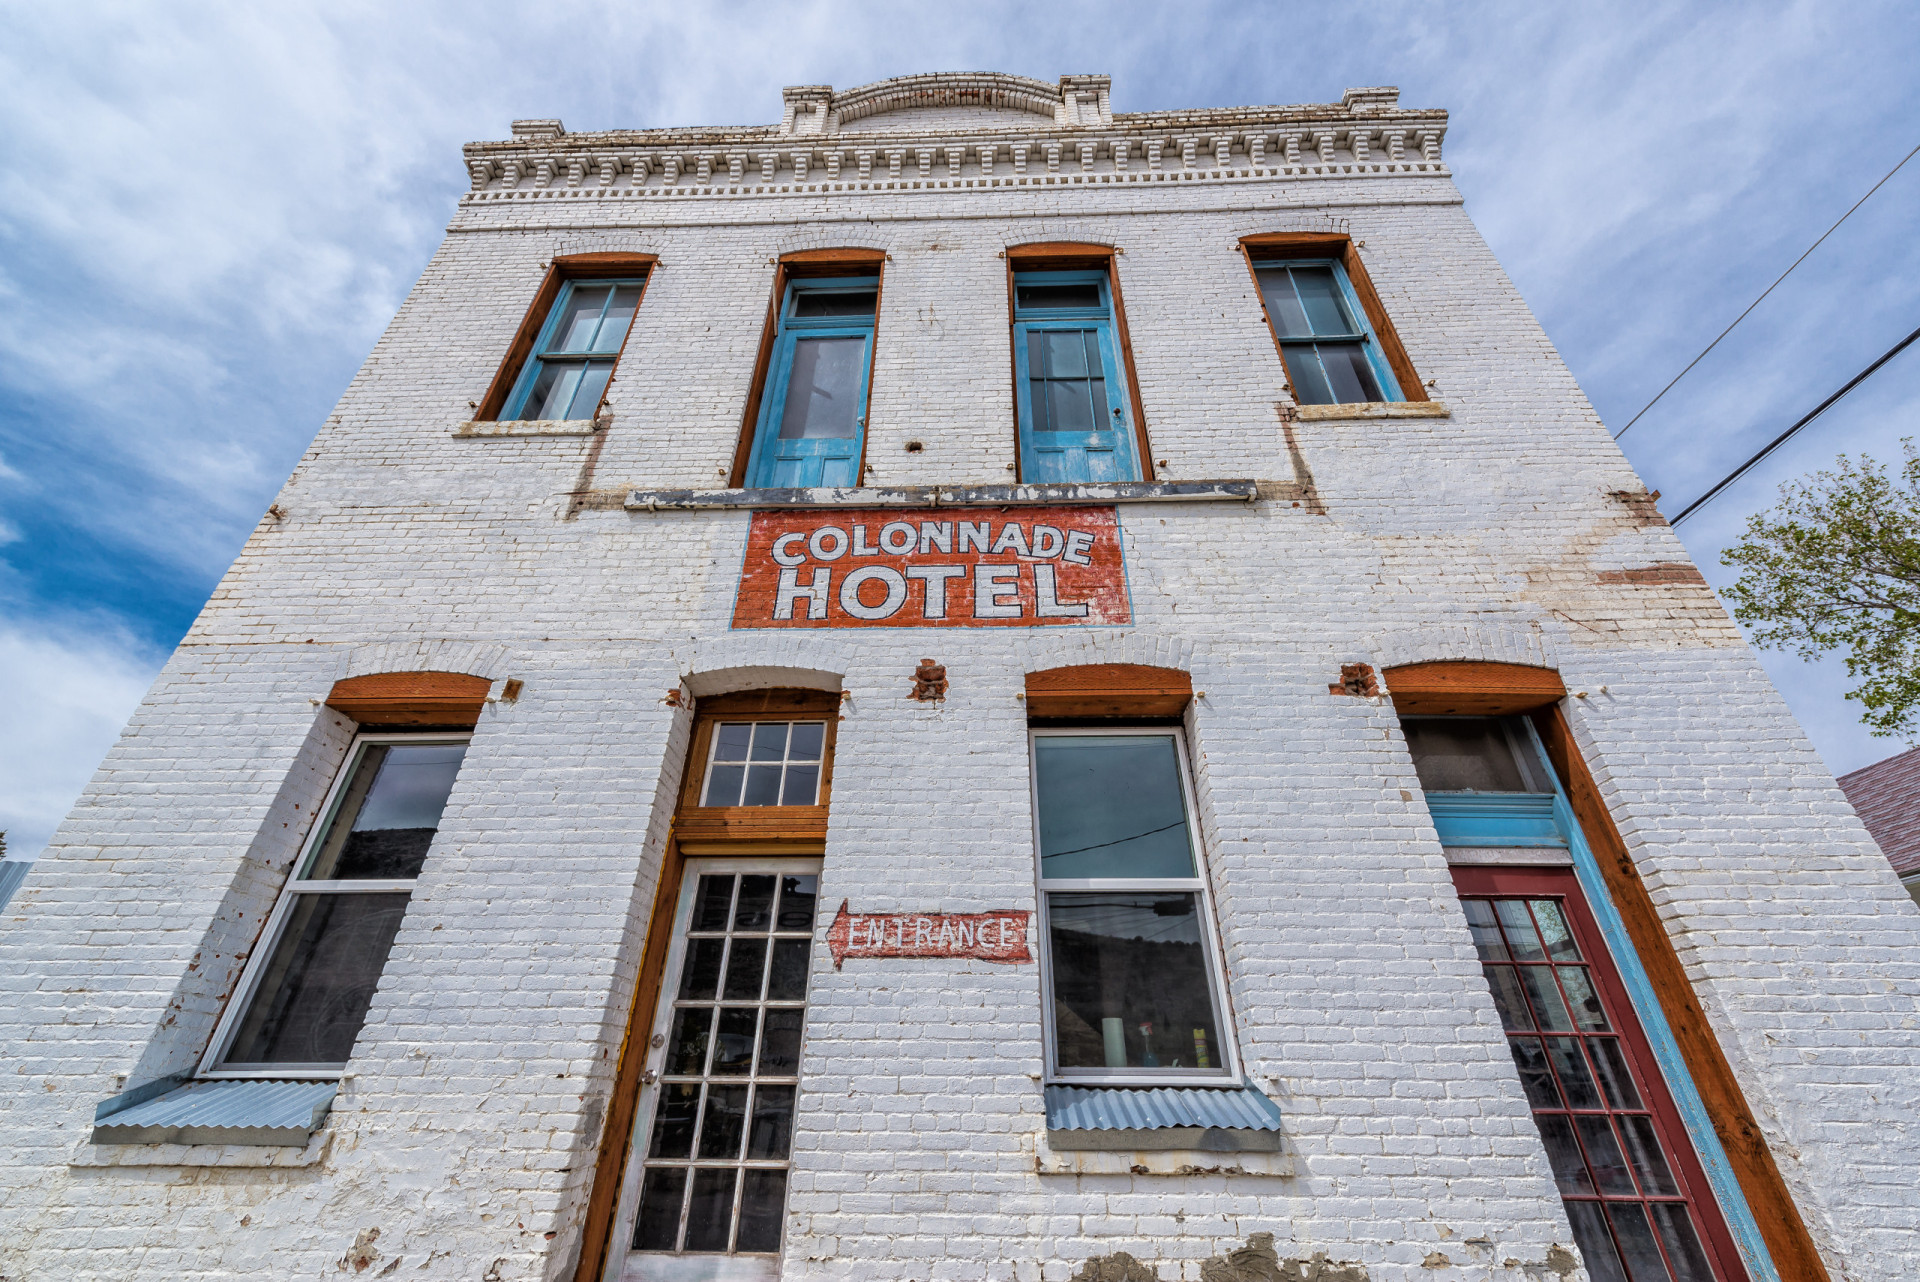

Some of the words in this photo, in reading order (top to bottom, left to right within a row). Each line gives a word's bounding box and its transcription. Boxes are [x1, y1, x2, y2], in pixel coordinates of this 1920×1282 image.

[772, 520, 1095, 566] COLONNADE
[773, 564, 1088, 620] HOTEL
[848, 917, 1014, 950] ENTRANCE
